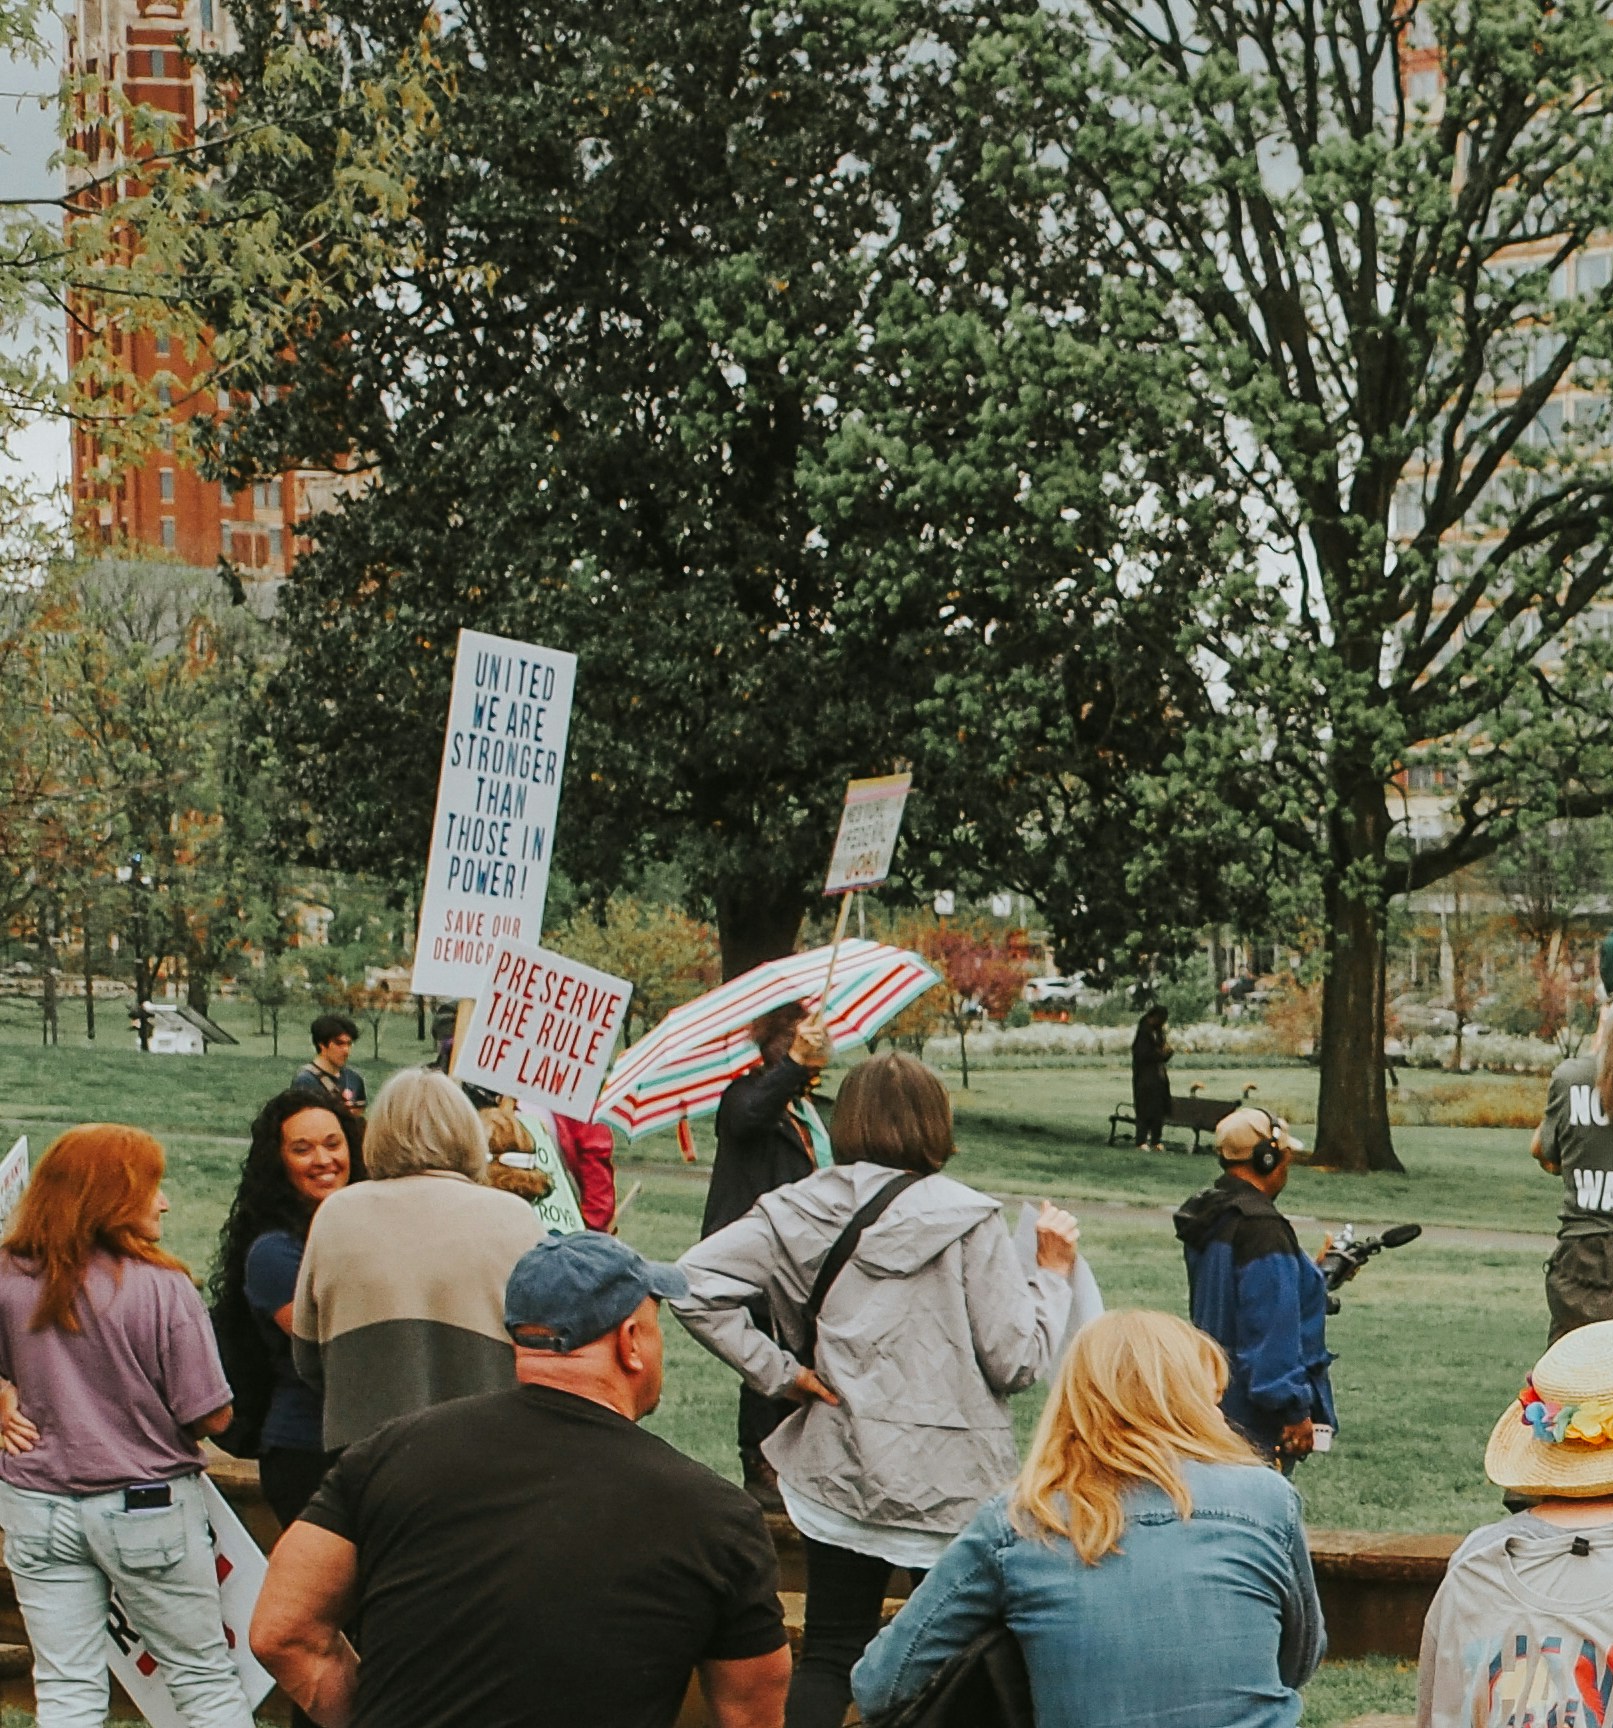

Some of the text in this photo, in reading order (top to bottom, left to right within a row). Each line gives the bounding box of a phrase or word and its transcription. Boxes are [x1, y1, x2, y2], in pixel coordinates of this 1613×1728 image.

[475, 651, 555, 701] UNITED
[473, 692, 546, 742] WE ARE
[451, 732, 557, 786] STRONGER
[475, 776, 527, 819] THAN
[446, 813, 545, 861] THOSE IN
[448, 856, 527, 899] POWER!
[444, 908, 520, 939] SAVE OUR
[494, 951, 621, 1029] PRESERVE
[487, 992, 603, 1065] THE RULE
[477, 1035, 581, 1100] OF LAW!
